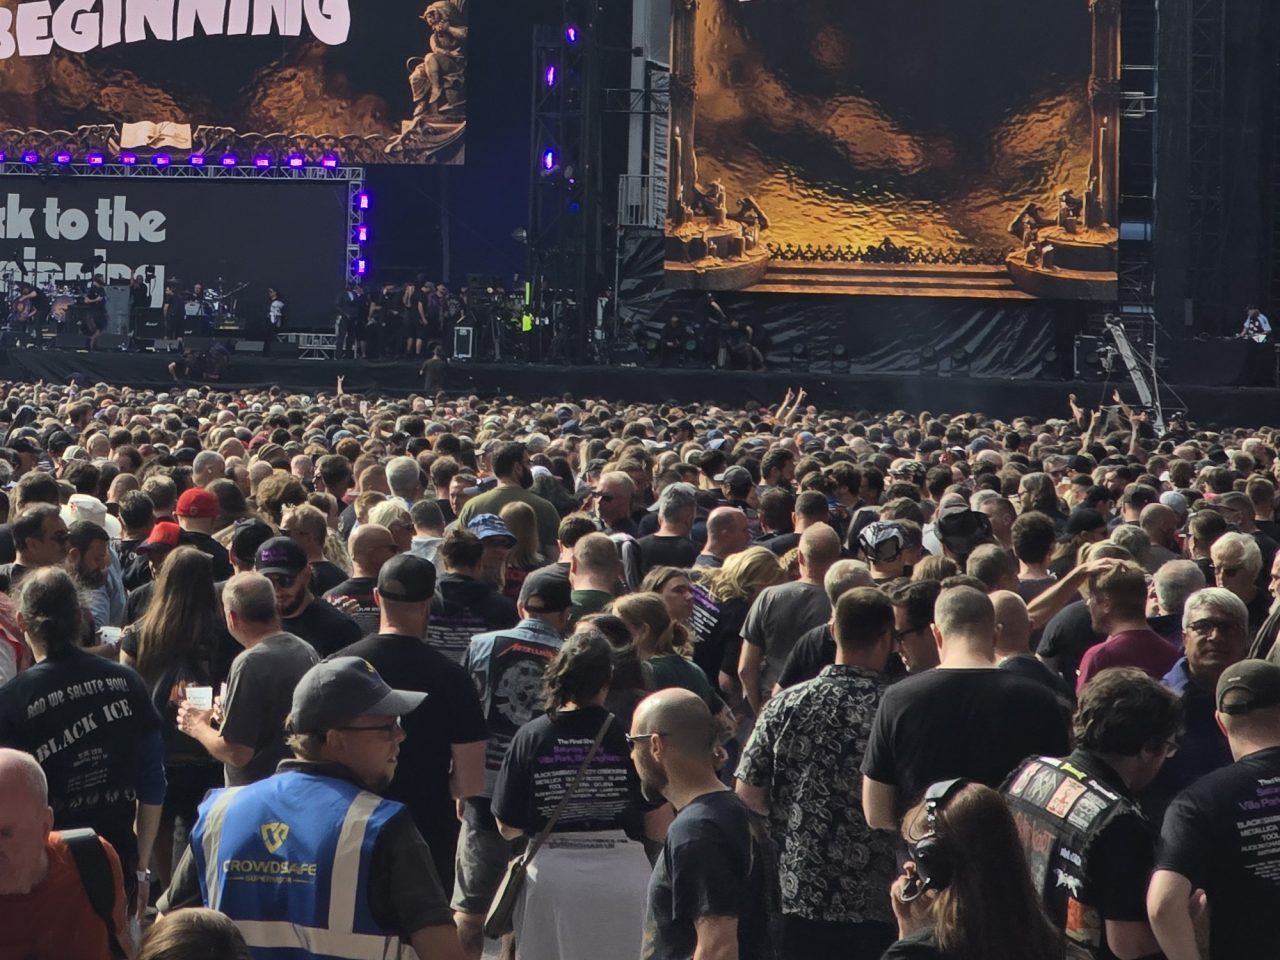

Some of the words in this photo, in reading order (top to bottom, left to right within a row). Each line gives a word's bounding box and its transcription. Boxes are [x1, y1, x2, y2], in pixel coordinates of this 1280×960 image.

[43, 197, 89, 240] to
[95, 195, 166, 242] the
[36, 713, 98, 763] BLACK
[102, 698, 132, 722] ICE
[223, 859, 317, 876] CROWDSAFE
